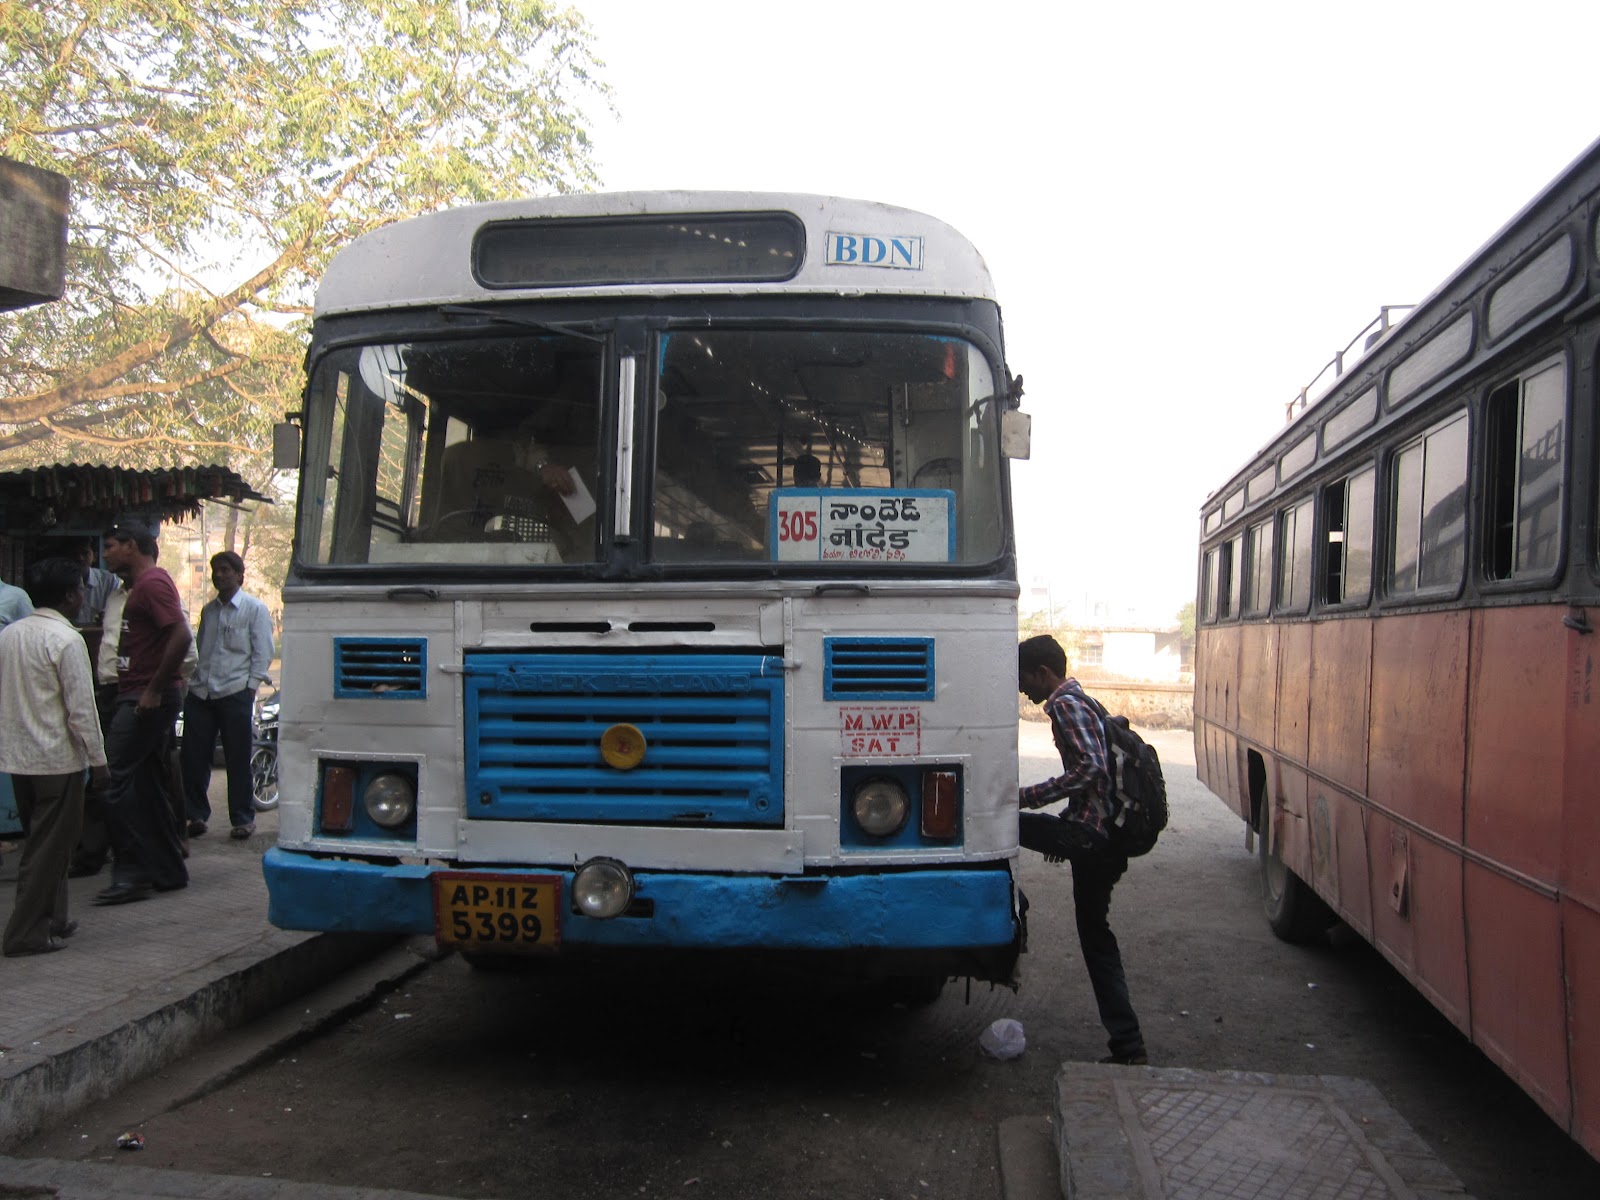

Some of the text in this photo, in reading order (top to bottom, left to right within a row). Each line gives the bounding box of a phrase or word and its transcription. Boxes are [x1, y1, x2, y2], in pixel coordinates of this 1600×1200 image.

[835, 235, 914, 266] BDN
[778, 511, 818, 542] 305
[829, 522, 918, 552] नांदेड
[498, 673, 750, 691] ASHOK LEYLAND
[845, 713, 915, 730] M.W.P
[851, 737, 900, 752] SAT
[452, 911, 542, 943] 5399
